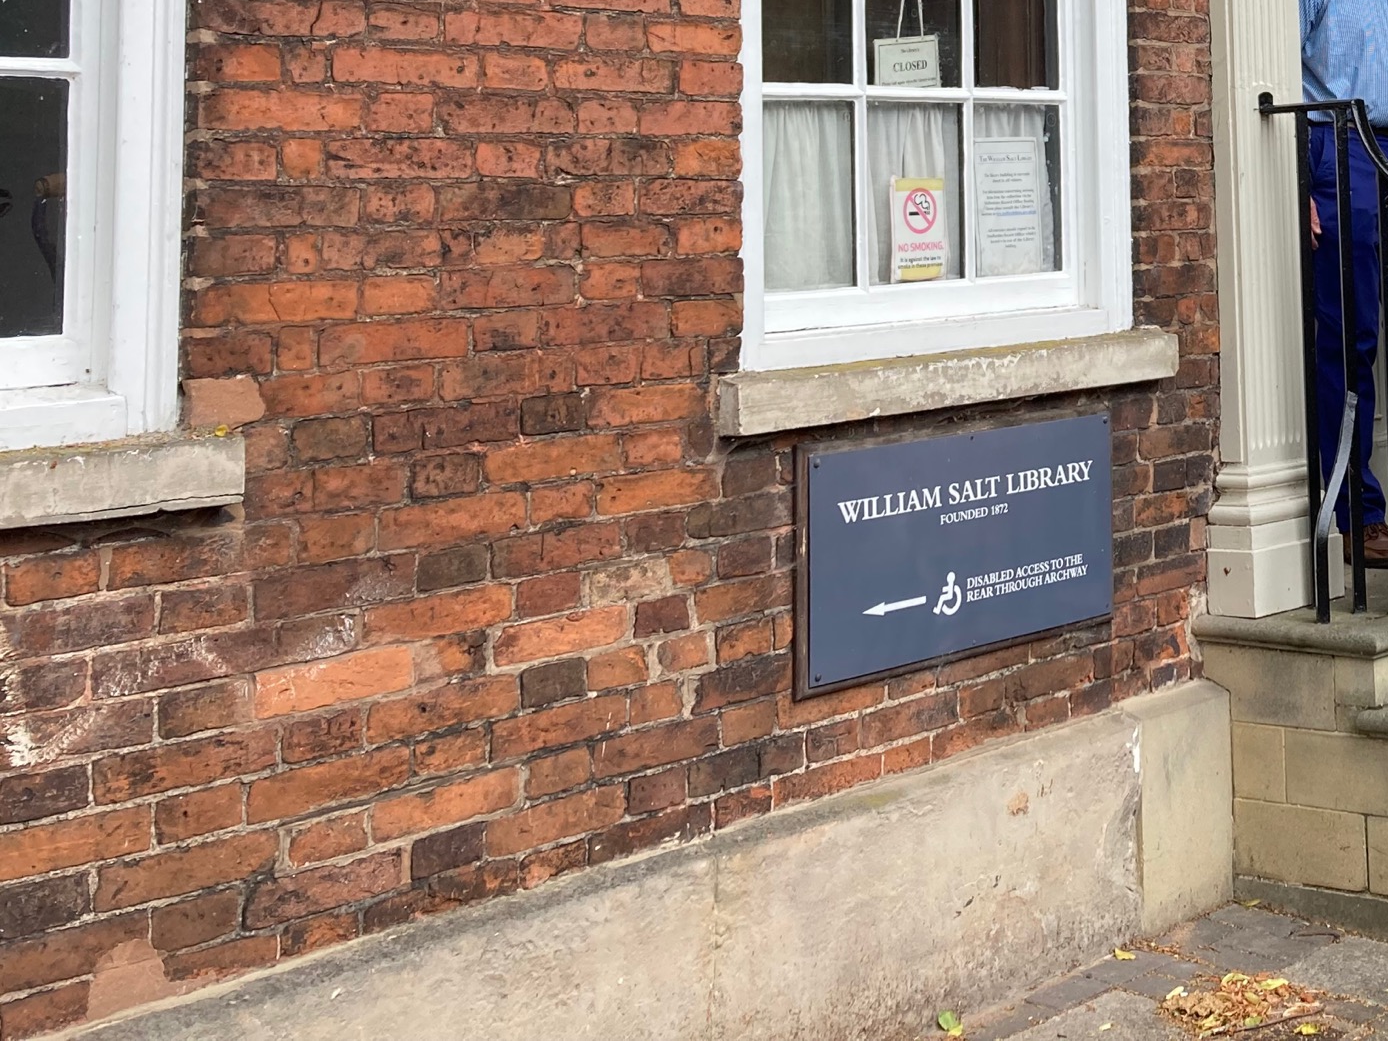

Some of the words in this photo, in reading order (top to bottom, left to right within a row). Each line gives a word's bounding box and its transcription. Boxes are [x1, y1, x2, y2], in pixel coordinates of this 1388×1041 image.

[893, 60, 928, 72] CLOSED
[898, 243, 909, 253] NO
[837, 485, 942, 524] WILLIAM
[948, 475, 1001, 505] SALT
[1006, 460, 1093, 494] LIBRARY
[940, 506, 989, 525] FOUNDED
[990, 503, 1009, 516] 1872
[966, 568, 1014, 589] DISABLED
[1015, 561, 1050, 579] ACCESS
[1050, 558, 1063, 570] TO
[1064, 553, 1083, 568] THE
[966, 586, 994, 602] REAR
[994, 578, 1043, 597] THROUGH
[1043, 564, 1089, 587] ARCHWAY
